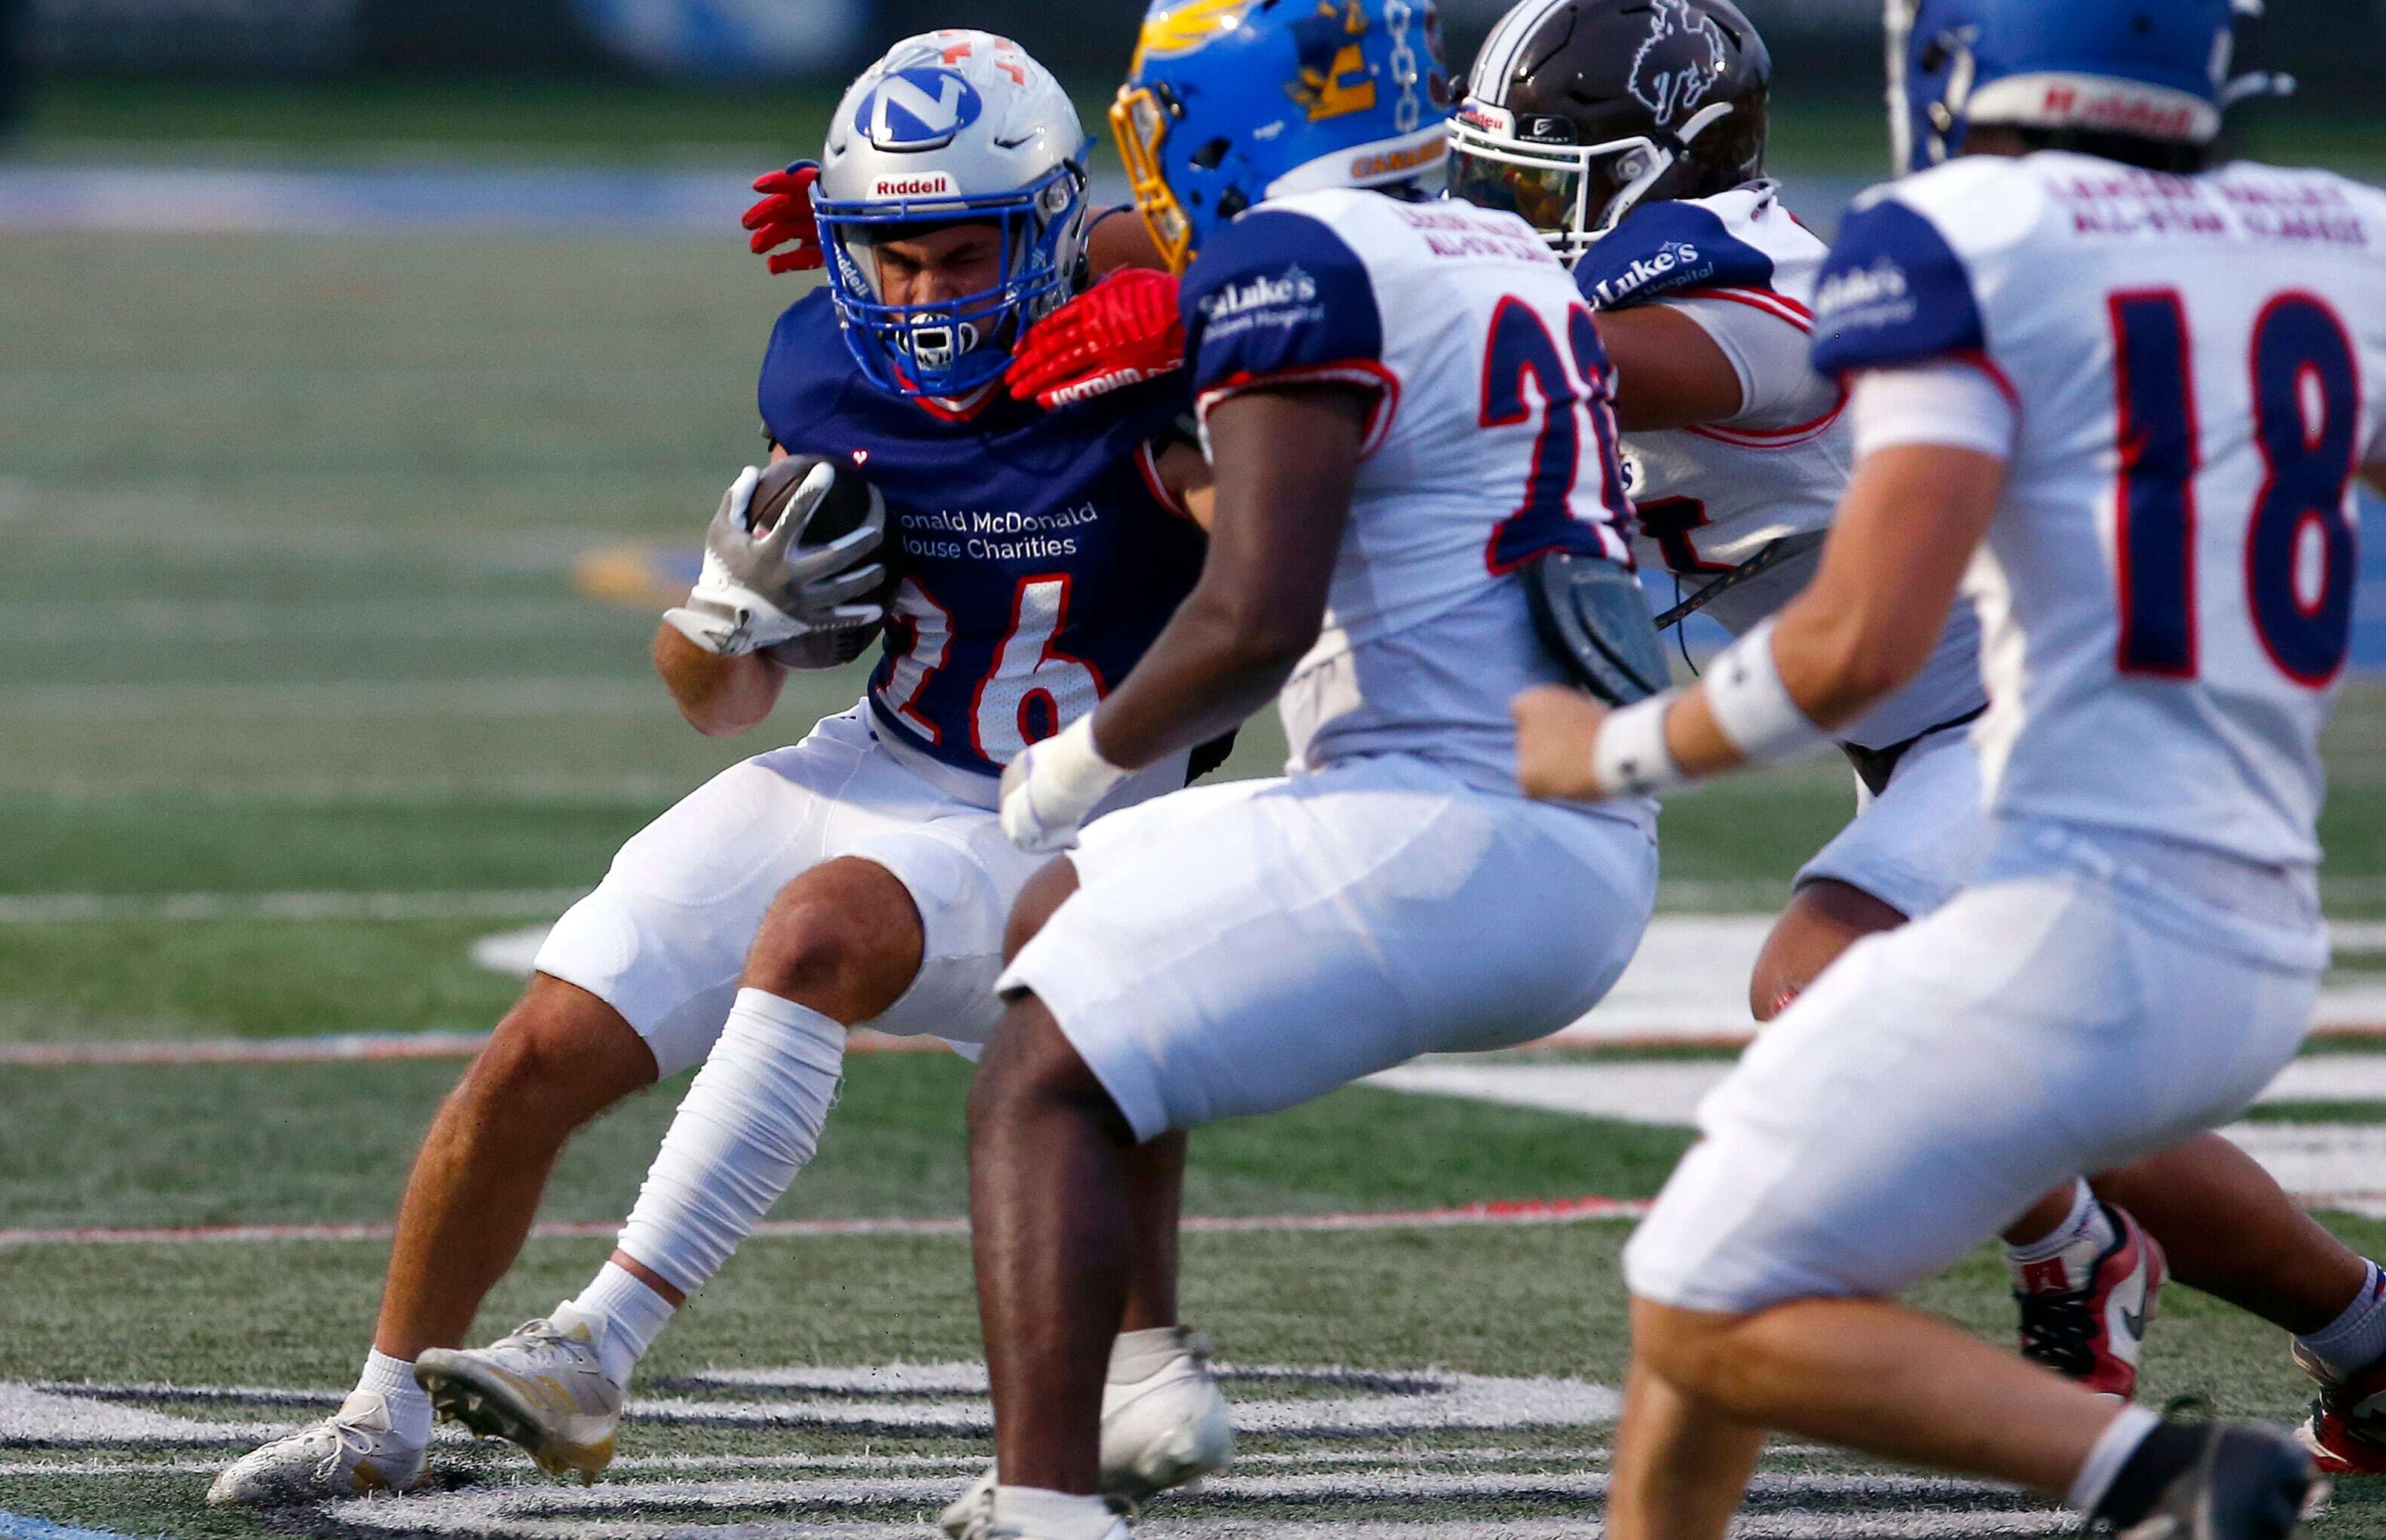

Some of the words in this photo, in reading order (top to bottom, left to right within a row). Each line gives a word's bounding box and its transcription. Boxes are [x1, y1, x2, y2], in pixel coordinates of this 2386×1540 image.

[870, 75, 967, 142] N
[876, 177, 947, 195] Riddell
[2106, 282, 2362, 691] 18
[901, 509, 968, 532] onald
[972, 501, 1097, 533] McDonald
[967, 536, 1077, 560] Charities
